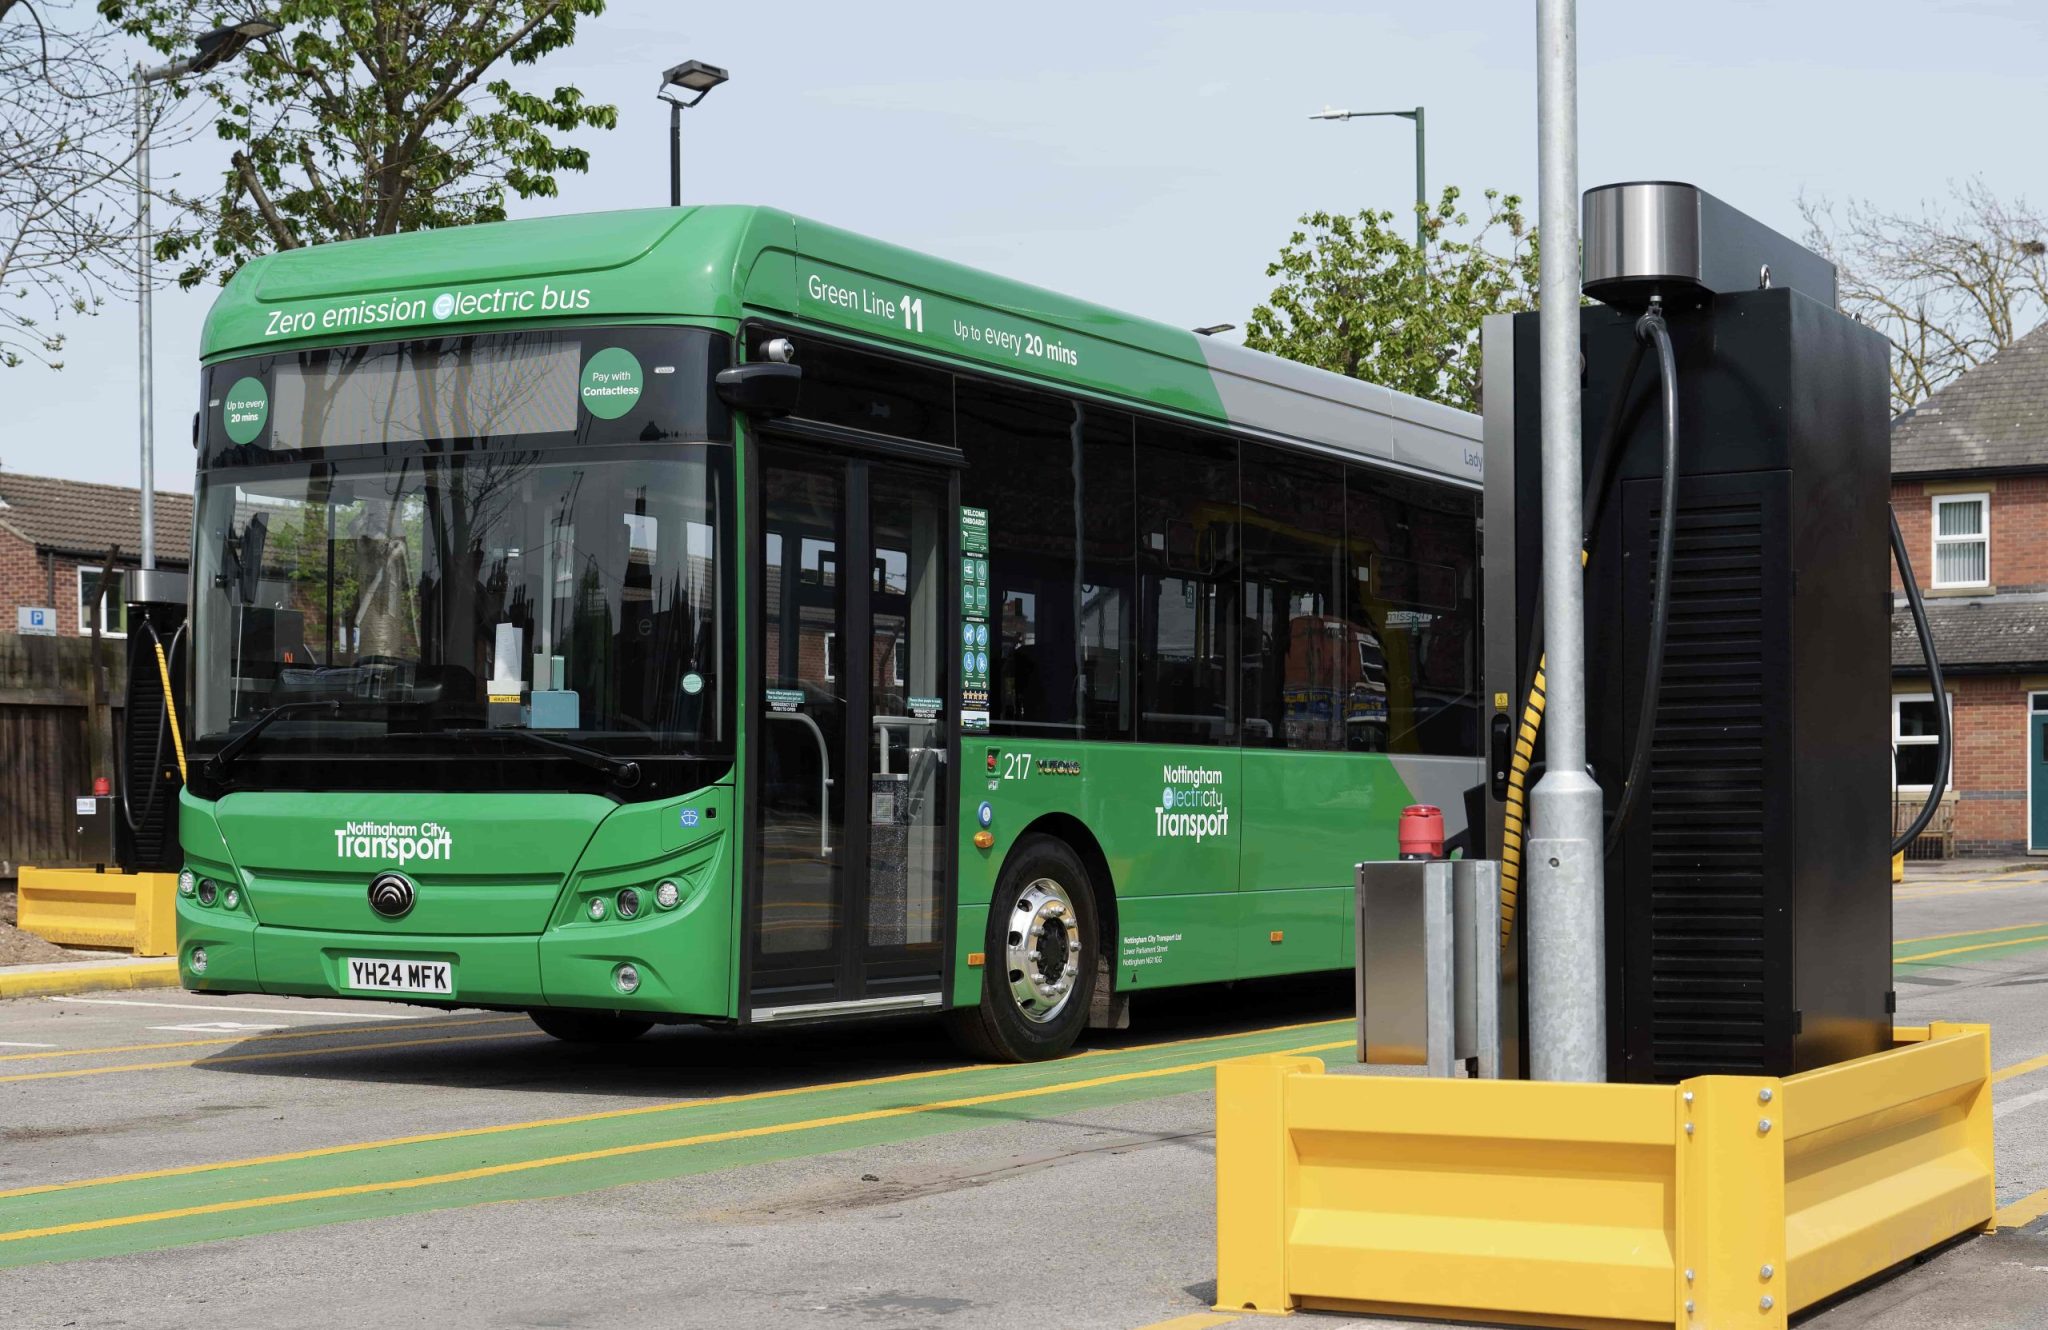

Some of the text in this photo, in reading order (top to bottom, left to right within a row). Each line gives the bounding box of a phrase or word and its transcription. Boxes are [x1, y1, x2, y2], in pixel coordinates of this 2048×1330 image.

[264, 285, 590, 335] Zero emission electric bus
[809, 274, 923, 333] Green Line 11
[954, 319, 1078, 366] Up to every 20 mins
[592, 371, 630, 383] Pay with
[583, 386, 639, 396] Contactless
[226, 402, 236, 411] Up
[245, 400, 265, 409] every
[231, 412, 258, 423] 20 mins
[1464, 448, 1482, 472] Lady
[963, 508, 985, 518] WELCOME
[1004, 753, 1032, 780] 217
[1164, 765, 1222, 788] Nottingham
[1162, 787, 1223, 812] electricity
[347, 822, 446, 840] Nottingham City
[1155, 806, 1228, 843] Transport
[335, 830, 452, 865] Transport
[1124, 936, 1147, 945] Nottingham
[1148, 935, 1156, 943] City
[1156, 934, 1175, 942] Transport
[1123, 958, 1146, 966] Nottingham
[352, 961, 446, 989] YH24 MFK
